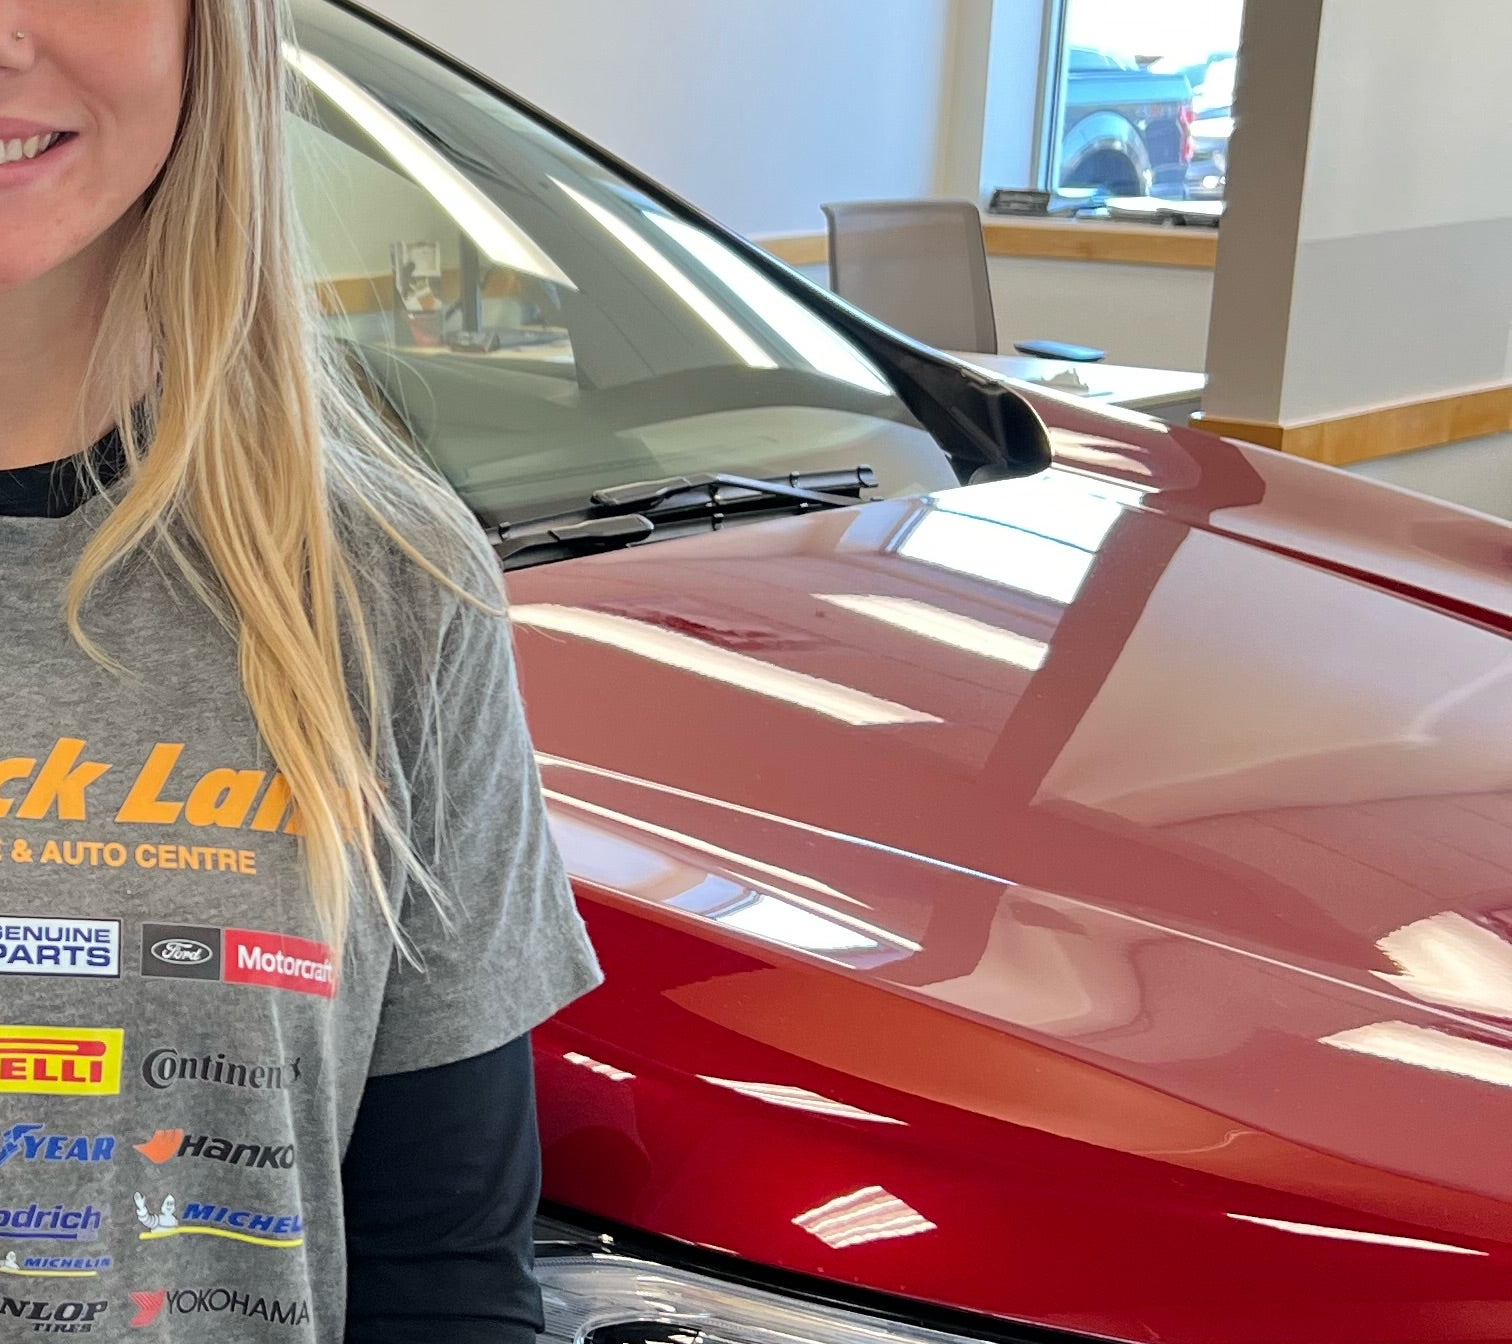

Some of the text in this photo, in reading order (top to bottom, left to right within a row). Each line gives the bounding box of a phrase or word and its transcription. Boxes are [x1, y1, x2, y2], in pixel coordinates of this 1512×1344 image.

[114, 742, 354, 844] La
[11, 838, 34, 864] &
[39, 839, 128, 869] AUTO
[134, 842, 258, 876] CENTRE
[161, 941, 204, 962] Ford
[141, 1047, 285, 1090] Continen
[177, 1134, 296, 1170] Hanko
[181, 1202, 304, 1234] MICHEL
[23, 1257, 113, 1269] MICHELIN
[166, 1288, 311, 1326] YOKOHAMA
[32, 1322, 93, 1334] TIRES
